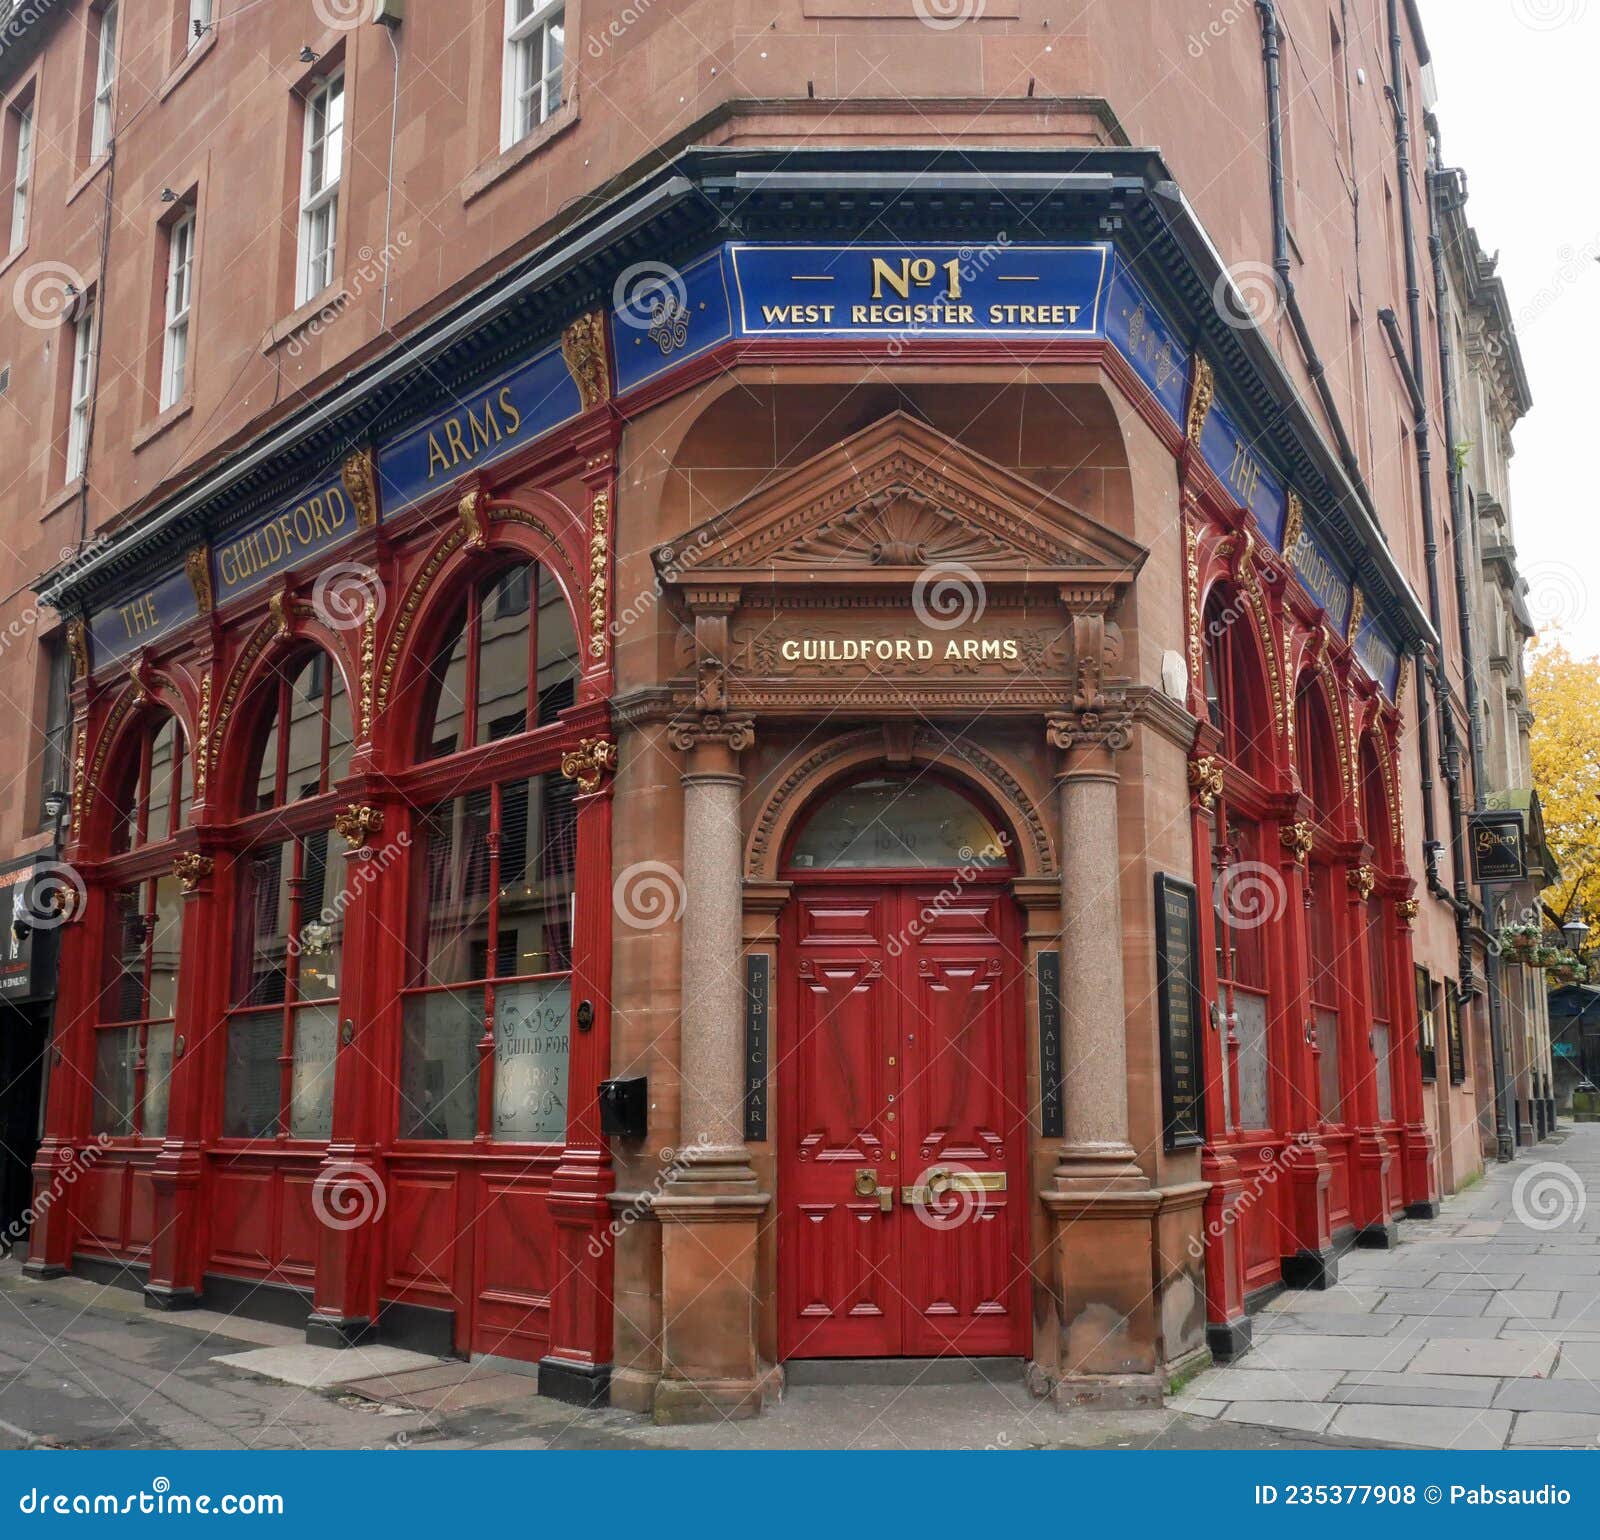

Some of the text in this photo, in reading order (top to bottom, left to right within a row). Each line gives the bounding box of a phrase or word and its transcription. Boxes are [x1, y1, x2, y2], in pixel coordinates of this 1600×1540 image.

[762, 304, 1080, 324] WEST REGISTER STREET
[119, 386, 521, 639] THE GUILDFORD ARMS
[1229, 438, 1262, 507] THE
[782, 639, 1019, 661] GUILDFORD ARMS
[751, 971, 763, 1122] PUBLIC BAR
[1043, 968, 1057, 1119] RESTAURANT
